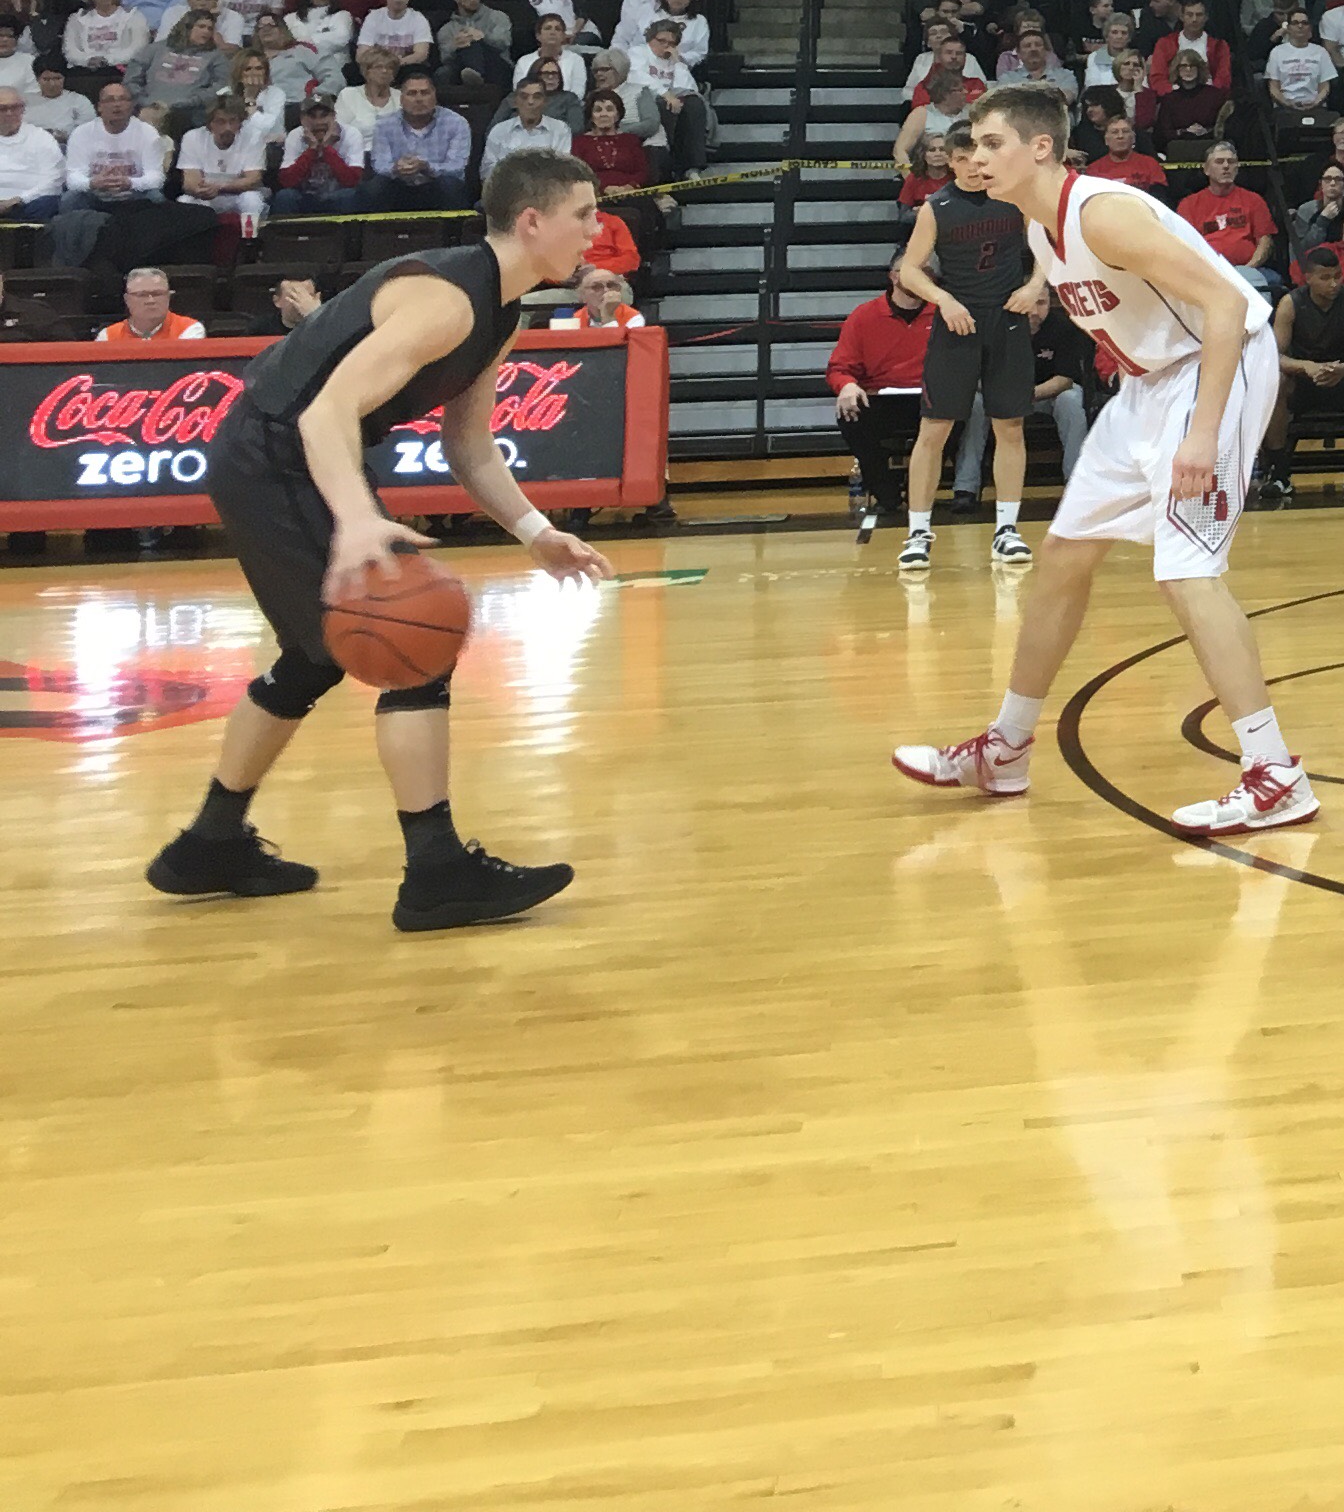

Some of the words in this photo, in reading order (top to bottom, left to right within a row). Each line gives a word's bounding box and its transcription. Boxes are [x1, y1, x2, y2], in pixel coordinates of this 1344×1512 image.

[975, 241, 998, 273] 2
[29, 370, 246, 449] Coca-Col
[76, 448, 209, 486] zero
[393, 437, 528, 474] zeo.
